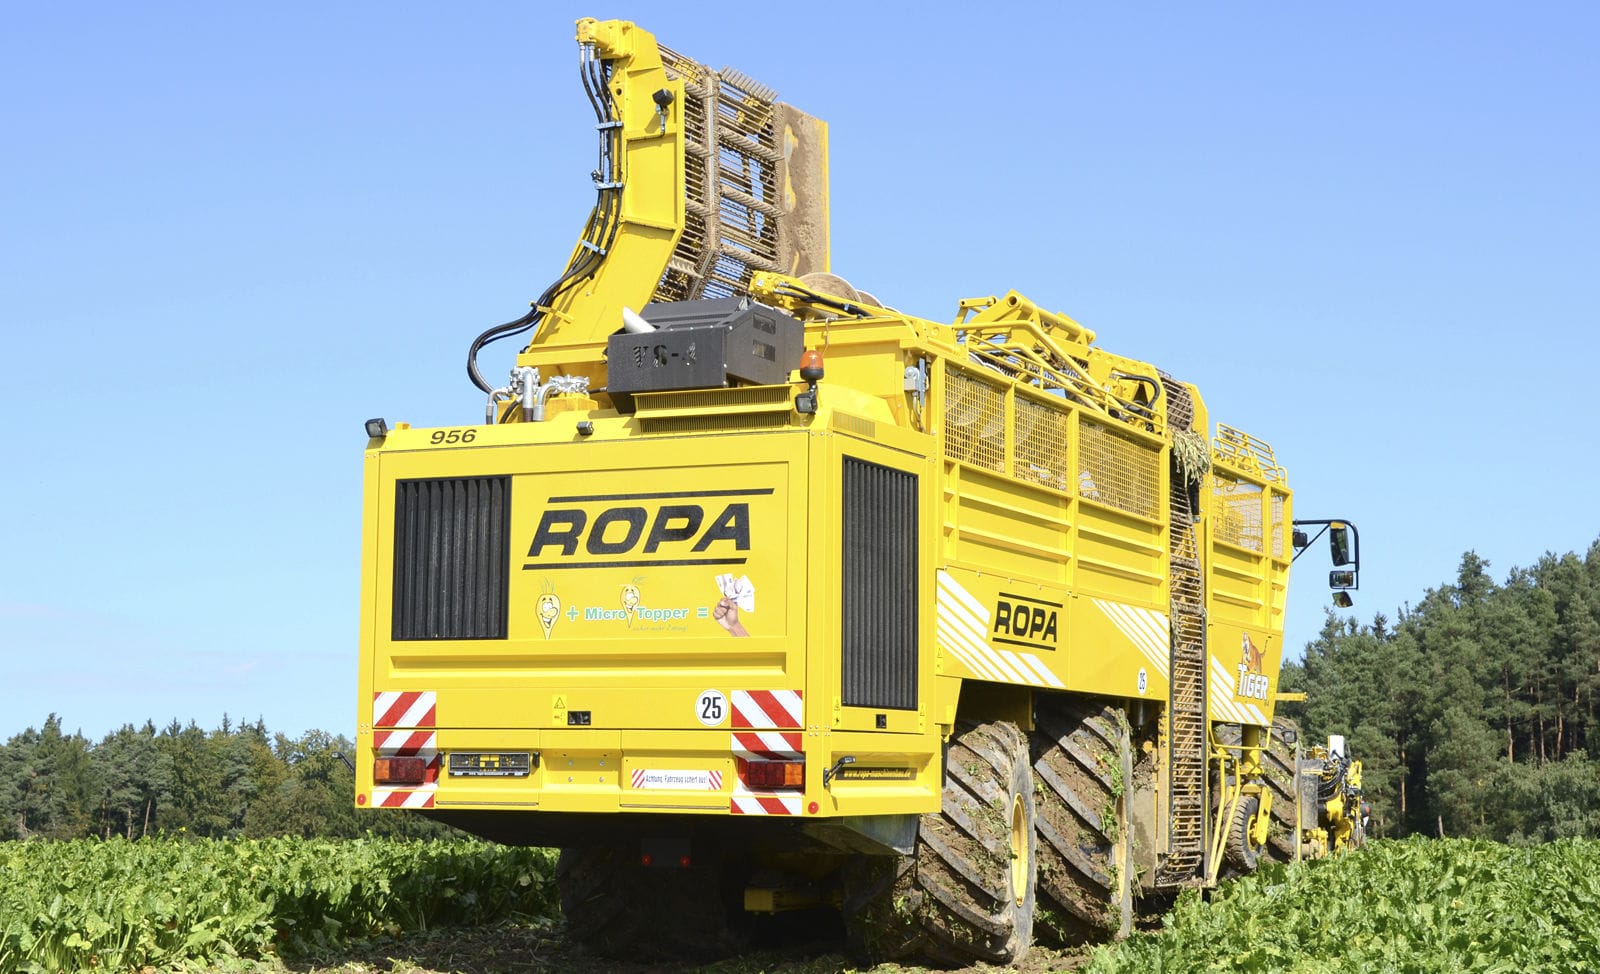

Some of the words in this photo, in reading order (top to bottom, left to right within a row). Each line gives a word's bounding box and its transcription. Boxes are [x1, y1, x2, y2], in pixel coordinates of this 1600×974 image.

[430, 428, 478, 445] 956
[526, 502, 751, 558] ROPA
[585, 607, 628, 621] Micro
[636, 606, 689, 622] Topper
[993, 600, 1057, 643] ROPA
[702, 696, 722, 719] 25
